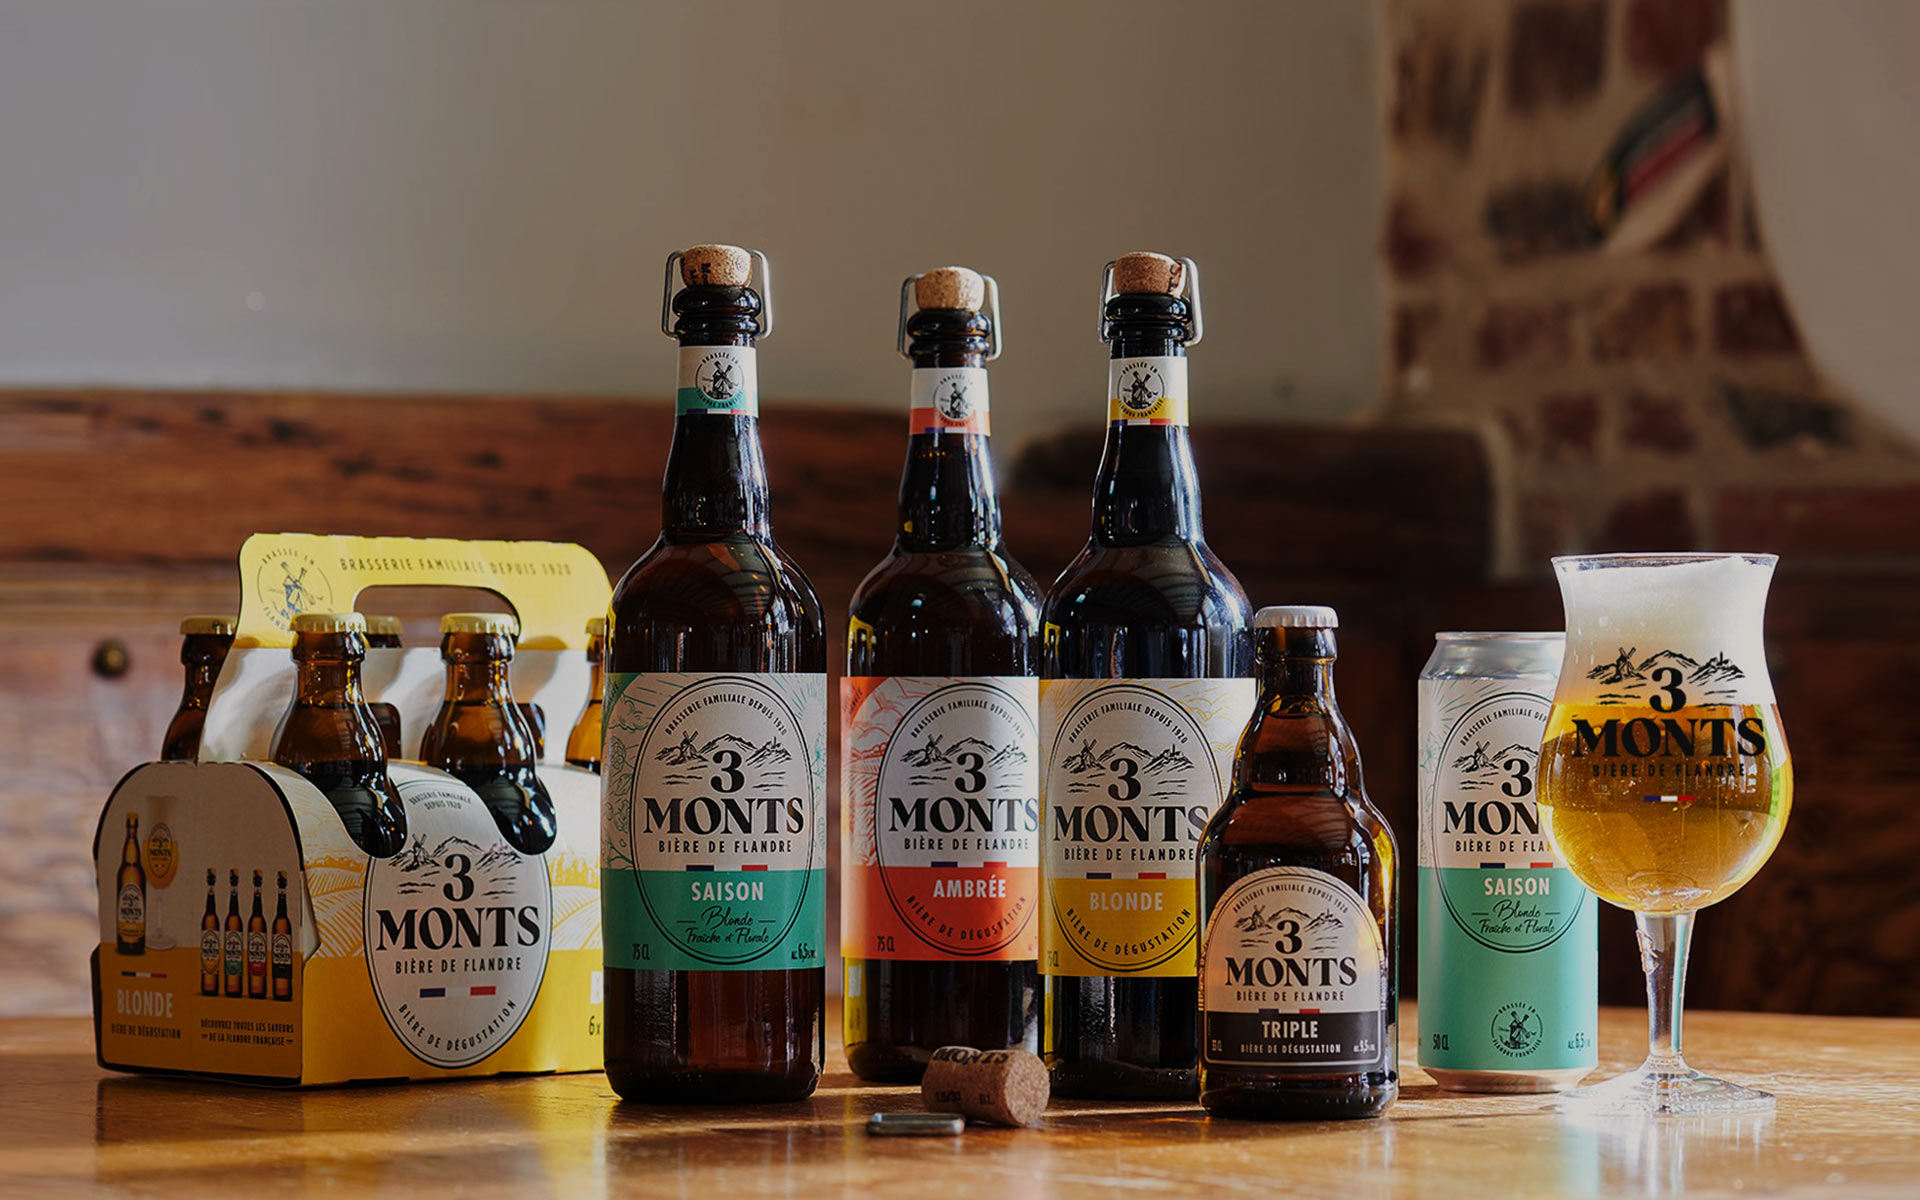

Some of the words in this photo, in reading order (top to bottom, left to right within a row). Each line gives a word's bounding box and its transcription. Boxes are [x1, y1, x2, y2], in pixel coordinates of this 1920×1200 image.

[340, 557, 413, 572] BRASSERIE
[419, 559, 484, 573] FAMILIALE
[489, 562, 536, 575] DEPUIS
[541, 563, 572, 576] 1920
[1649, 667, 1686, 713] 3
[665, 701, 701, 735] BRASSERIE
[703, 694, 746, 706] FAMILIALE
[748, 698, 774, 719] DEPUIS
[773, 717, 787, 736] 1920
[911, 706, 946, 738] BRASSERIE
[947, 699, 988, 712] FAMILIALE
[989, 704, 1014, 724] DEPUIS
[1069, 711, 1100, 743] BRASSERIE
[1101, 703, 1142, 715] FAMILIALE
[1144, 706, 1172, 727] DEPUIS
[1171, 725, 1188, 744] 1920
[1460, 715, 1492, 745] BRASSERIE
[1494, 708, 1532, 720] FAMILIALE
[1572, 717, 1766, 757] MONTS
[711, 750, 745, 794] 3
[954, 752, 987, 794] 3
[1108, 758, 1141, 801] 3
[1501, 758, 1532, 797] 3
[1593, 762, 1637, 777] BIÈRE
[1649, 764, 1665, 777] DE
[1676, 763, 1745, 777] FLANDRE
[643, 797, 804, 834] MONTS
[889, 797, 1039, 833] MONTS
[1054, 805, 1209, 842] MONTS
[1443, 801, 1540, 835] MON
[659, 838, 699, 853] BIÈRE
[708, 840, 725, 853] DE
[734, 839, 792, 853] FLANDRE
[904, 836, 944, 850] BIÈRE
[952, 838, 969, 850] DE
[977, 838, 1029, 850] FLANDRE
[1064, 845, 1098, 860] BIÈRE
[1106, 848, 1122, 860] DE
[1131, 848, 1194, 860] FLANDRE
[1456, 838, 1491, 852] BIÈRE
[1500, 840, 1514, 852] DE
[443, 854, 474, 902] 3
[691, 881, 764, 901] SAISON
[933, 874, 1006, 898] AMBRÉE
[1484, 877, 1550, 896] SAISON
[1090, 892, 1164, 911] BLONDE
[1233, 889, 1264, 913] BRASSERIE
[1267, 884, 1304, 893] FAMILIALE
[1307, 887, 1333, 902] DEPUIS
[1493, 899, 1541, 921] Blonde
[376, 905, 541, 950] MONTS
[700, 905, 754, 930] Blonde
[906, 895, 935, 926] BIÈRE
[939, 924, 953, 937] DE
[960, 896, 1026, 941] DÉGUSTATION
[1066, 908, 1091, 941] BIÈRE
[1094, 938, 1107, 952] DE
[1115, 908, 1191, 955] DÉGUSTATION
[1514, 924, 1523, 933] et
[1524, 919, 1555, 935] Florale
[723, 933, 732, 943] et
[735, 927, 769, 944] Florale
[1275, 920, 1302, 954] 3
[395, 957, 433, 974] BIÈRE
[441, 959, 456, 973] DE
[464, 956, 521, 972] FLANDRE
[1225, 957, 1357, 987] MONTS
[117, 989, 173, 1018] BLONDE
[1236, 989, 1267, 1001] BIÈRE
[1274, 991, 1286, 1001] DE
[1294, 990, 1345, 1001] FLANDRE
[128, 1025, 137, 1036] DE
[138, 1024, 181, 1039] DÉGUSTATION
[201, 1018, 232, 1030] DÉCOUVREZ
[233, 1020, 254, 1031] TOUTES
[255, 1022, 266, 1032] LES
[267, 1023, 294, 1033] SAVEURS
[209, 1032, 217, 1041] DE
[218, 1034, 225, 1042] LA
[226, 1034, 251, 1044] FLANDRE
[252, 1036, 285, 1046] FRANÇAISE
[398, 1003, 424, 1037] BIÈRE
[427, 1036, 441, 1049] DE
[446, 999, 517, 1051] DÉGUSTATION
[1261, 1020, 1318, 1039] TRIPLE
[1240, 1042, 1264, 1054] BIÈRE
[1267, 1043, 1278, 1054] DE
[1281, 1042, 1341, 1054] DÉGUSTATION
[1433, 1034, 1441, 1050] 50
